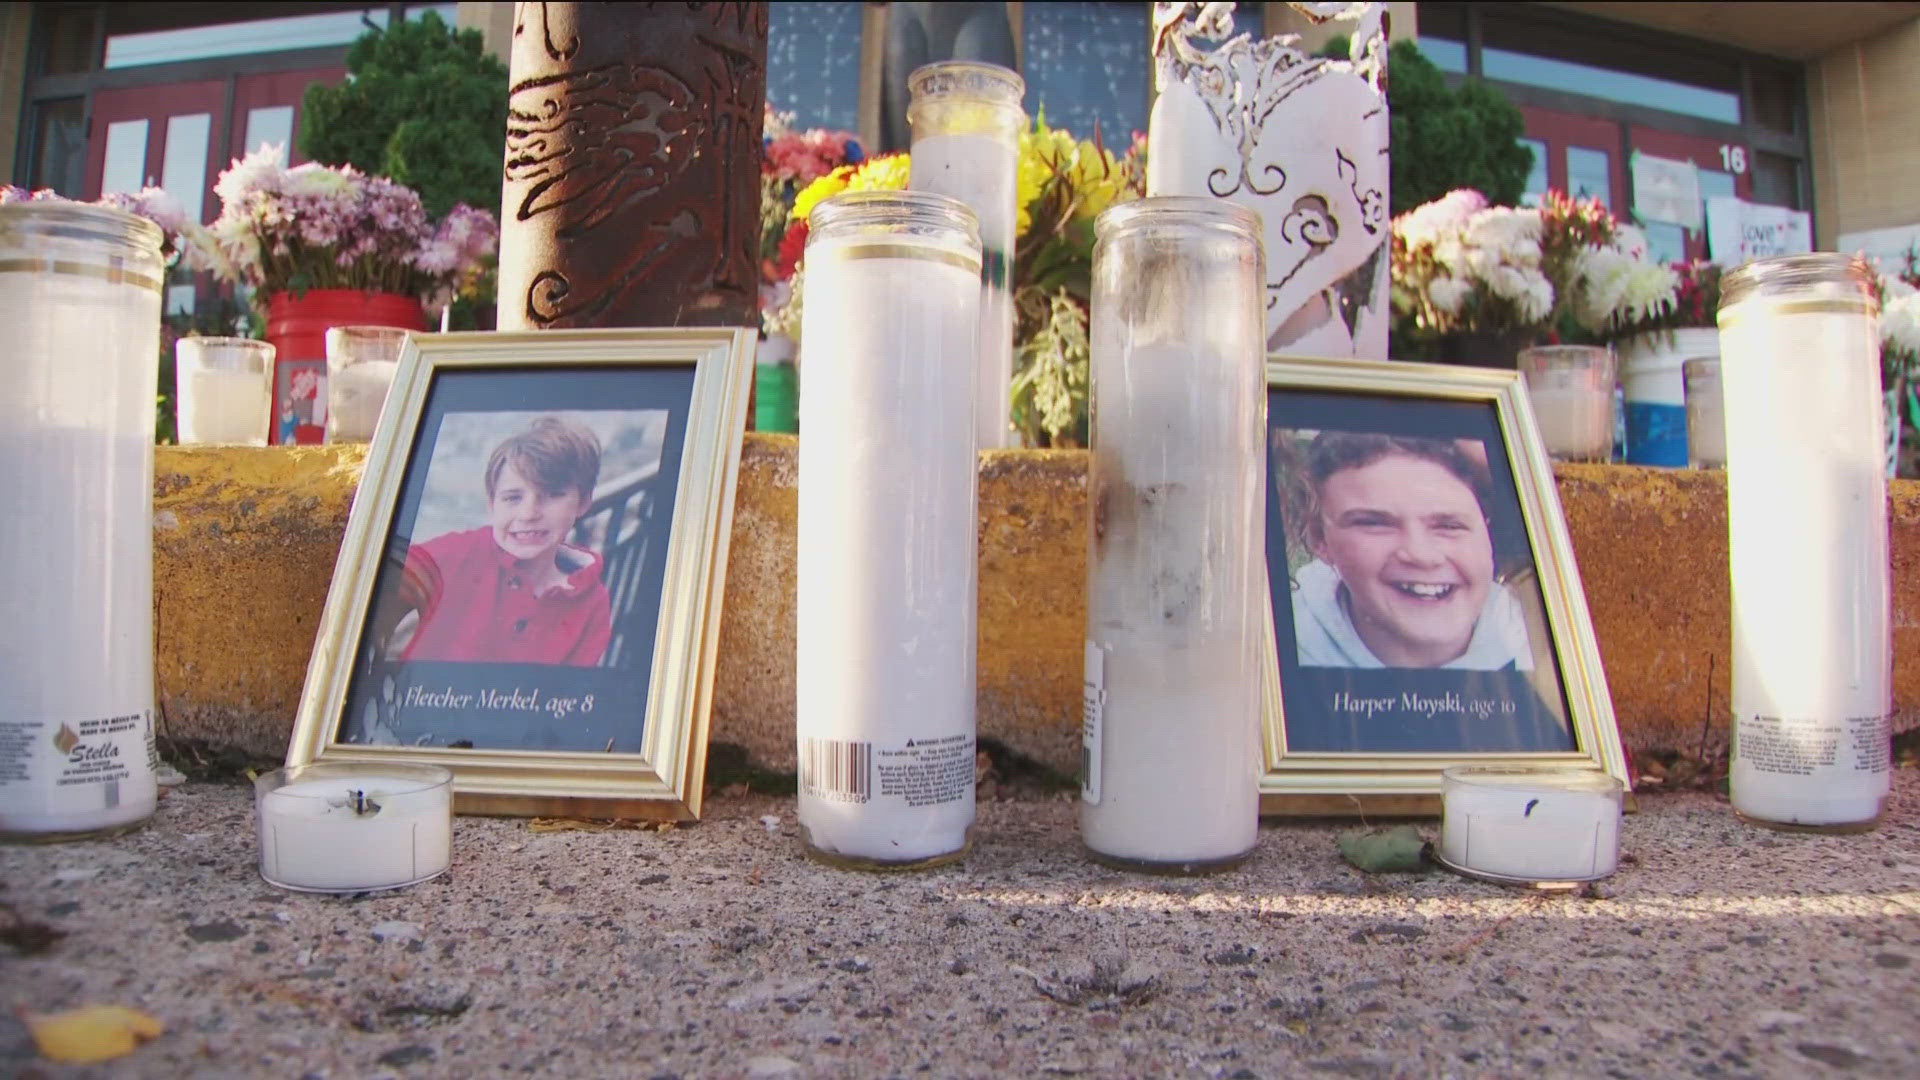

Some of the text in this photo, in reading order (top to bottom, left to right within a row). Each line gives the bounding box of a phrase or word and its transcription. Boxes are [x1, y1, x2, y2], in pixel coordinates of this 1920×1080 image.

[1719, 144, 1747, 175] 16
[403, 685, 594, 719] Fletcher Merkel, age 8
[1333, 691, 1516, 720] Harper Moyski, age 10
[69, 741, 119, 763] Stella
